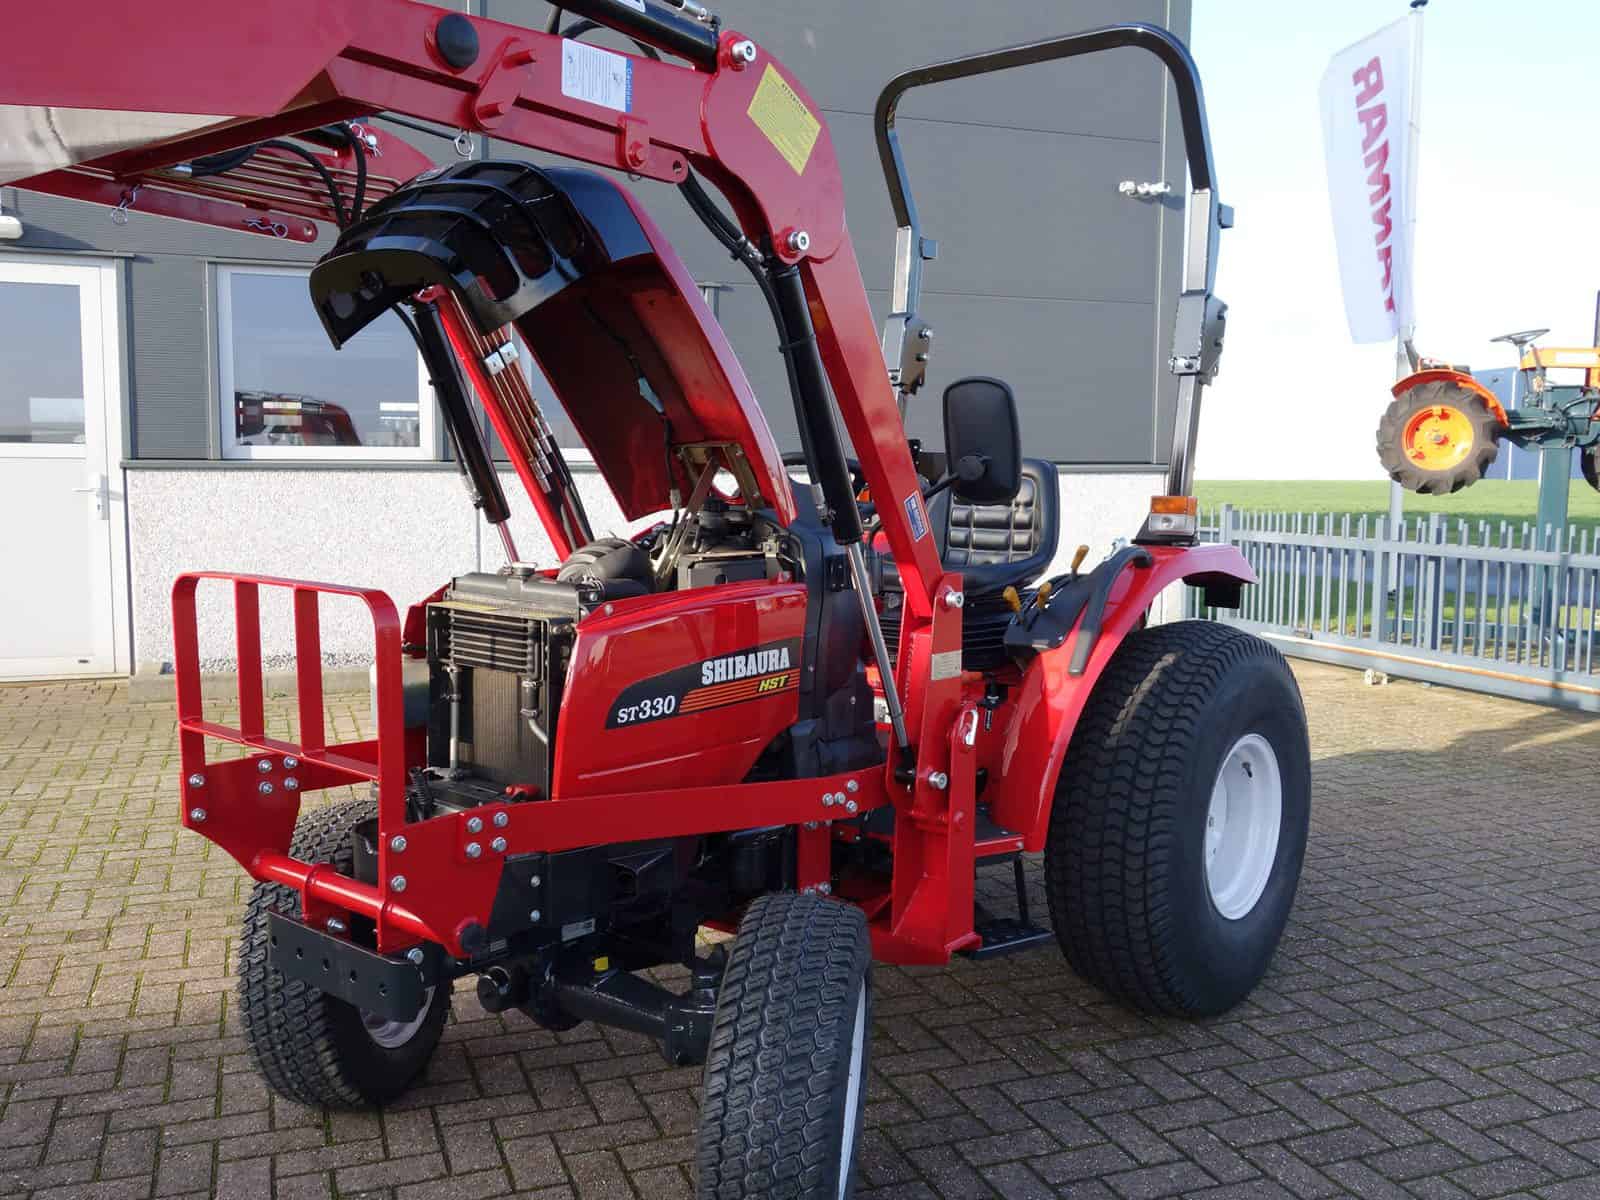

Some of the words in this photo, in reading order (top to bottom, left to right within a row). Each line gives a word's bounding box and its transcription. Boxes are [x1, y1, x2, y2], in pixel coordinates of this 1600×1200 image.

[701, 648, 791, 686] SHIBAURA
[758, 675, 790, 692] HST
[616, 695, 676, 724] ST330
